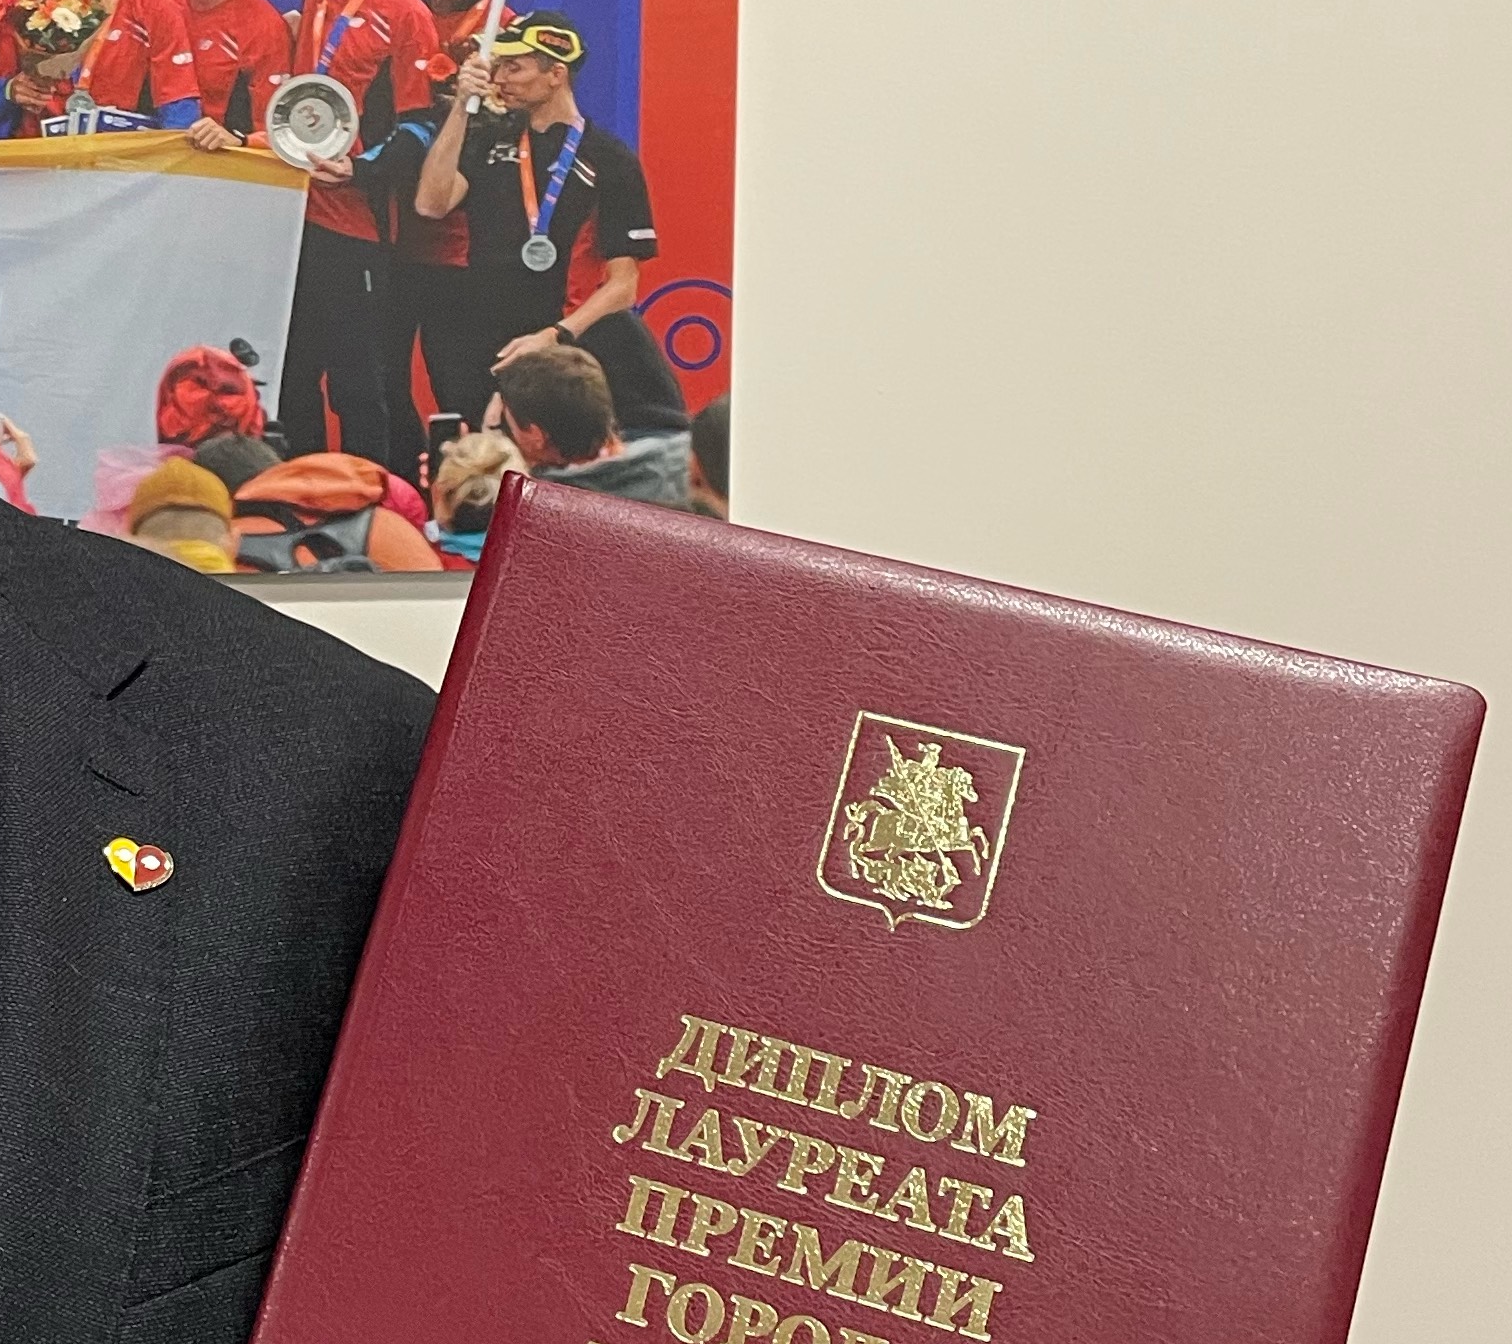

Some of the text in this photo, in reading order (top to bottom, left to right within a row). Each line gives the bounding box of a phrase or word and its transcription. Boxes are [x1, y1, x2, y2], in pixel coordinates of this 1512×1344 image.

[656, 1014, 1037, 1167] ДИПЛОМ
[613, 1088, 1035, 1262] ЛАУРЕАТА
[615, 1175, 1003, 1342] ПРЕМИИ
